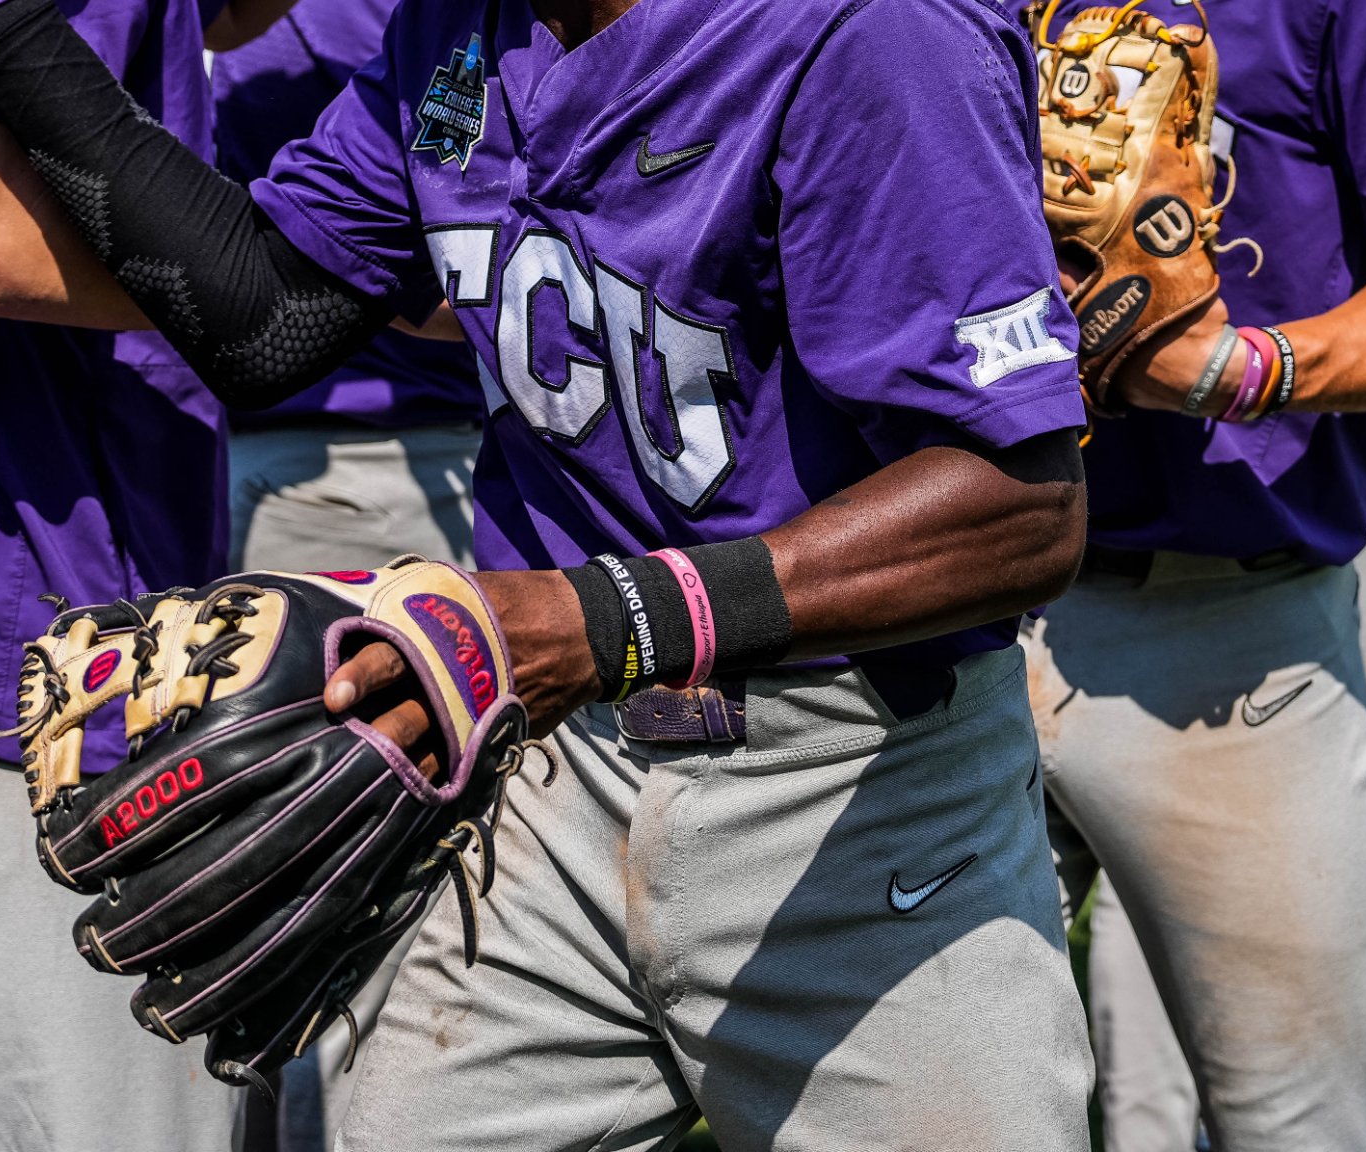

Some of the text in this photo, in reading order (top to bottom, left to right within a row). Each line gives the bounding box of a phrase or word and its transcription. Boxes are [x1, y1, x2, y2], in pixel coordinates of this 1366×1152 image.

[422, 100, 481, 135] WORLD SERIES
[444, 90, 475, 114] COLLEGE
[620, 581, 644, 611] DAY
[633, 611, 655, 675] OPENING
[695, 594, 713, 666] Support Ethiopia
[98, 757, 205, 848] A2000
